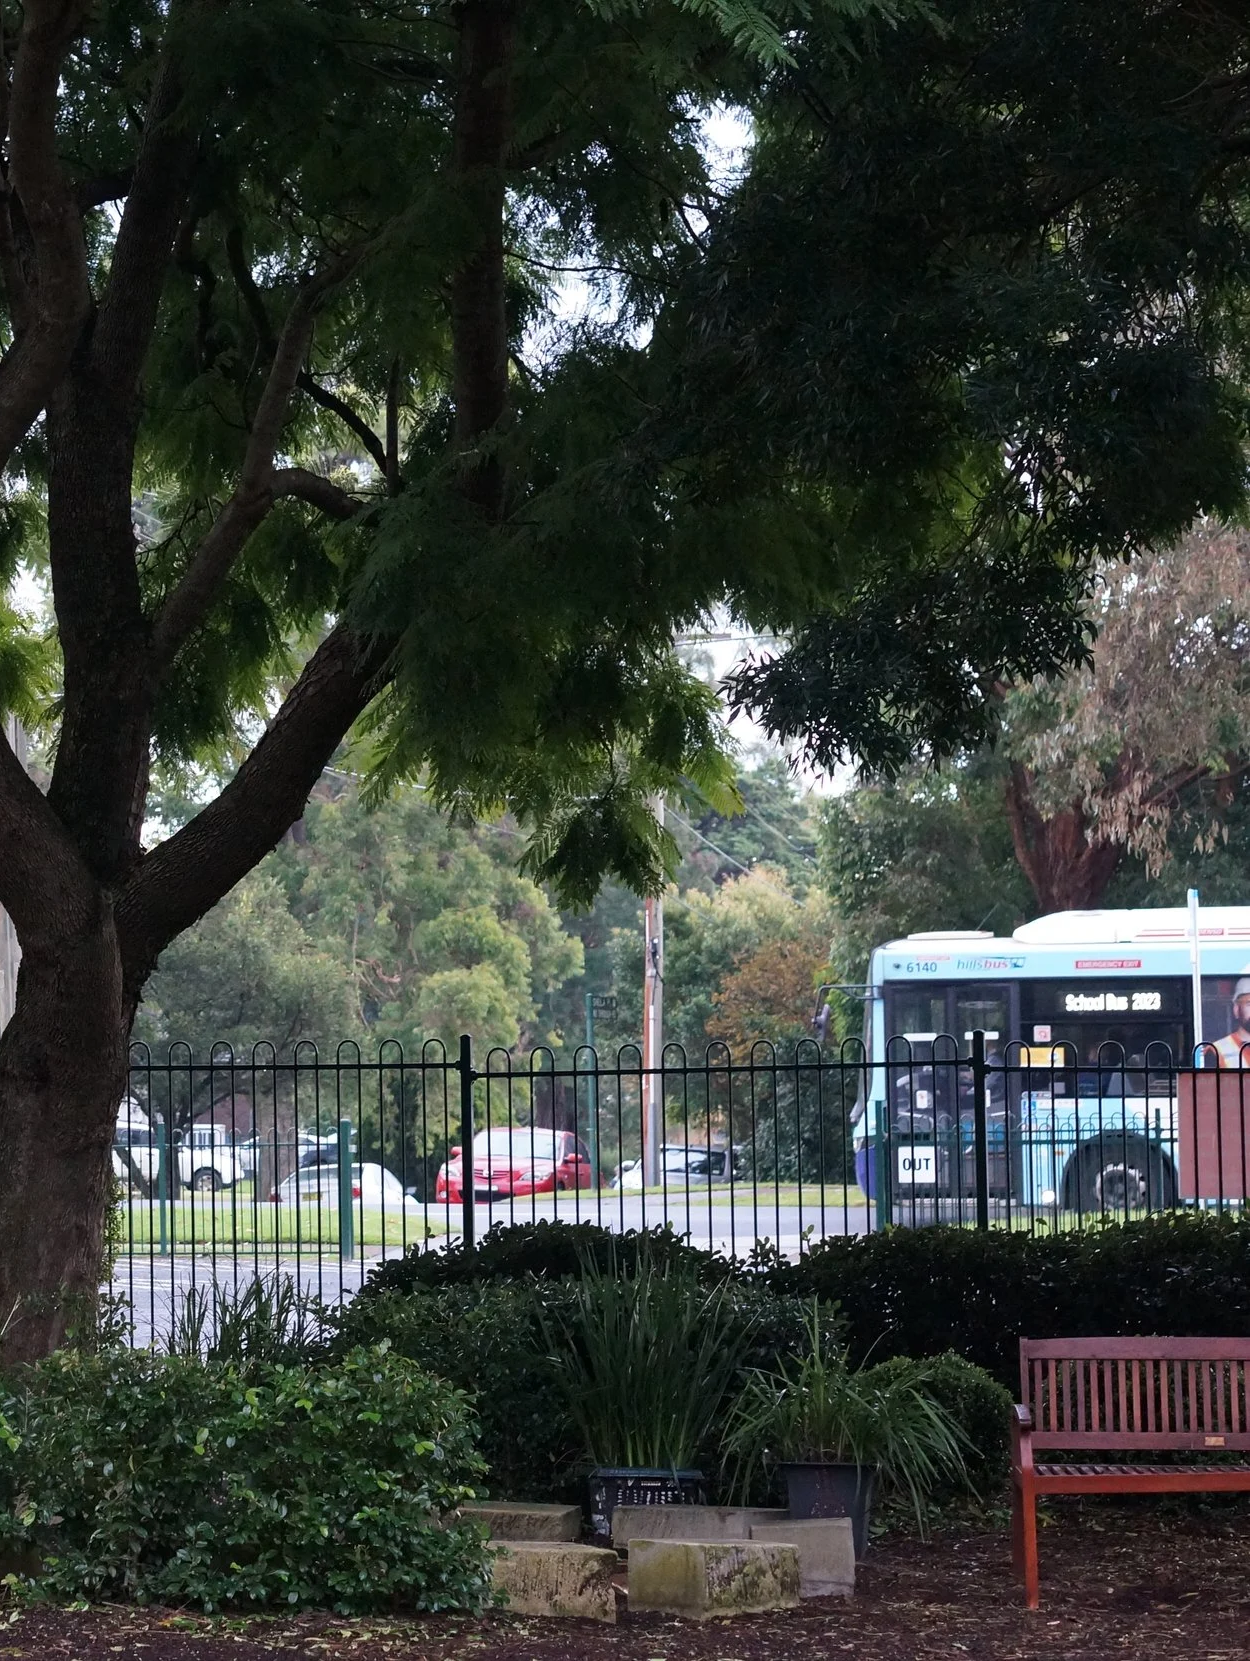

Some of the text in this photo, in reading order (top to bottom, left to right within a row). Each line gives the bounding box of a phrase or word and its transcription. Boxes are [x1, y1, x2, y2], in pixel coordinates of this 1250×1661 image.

[906, 962, 938, 973] 6140
[956, 959, 1008, 970] hillsbus
[1077, 960, 1122, 968] EMERGENCY
[1065, 993, 1105, 1012] School
[1105, 992, 1129, 1011] Bus
[902, 1157, 932, 1171] OUT
